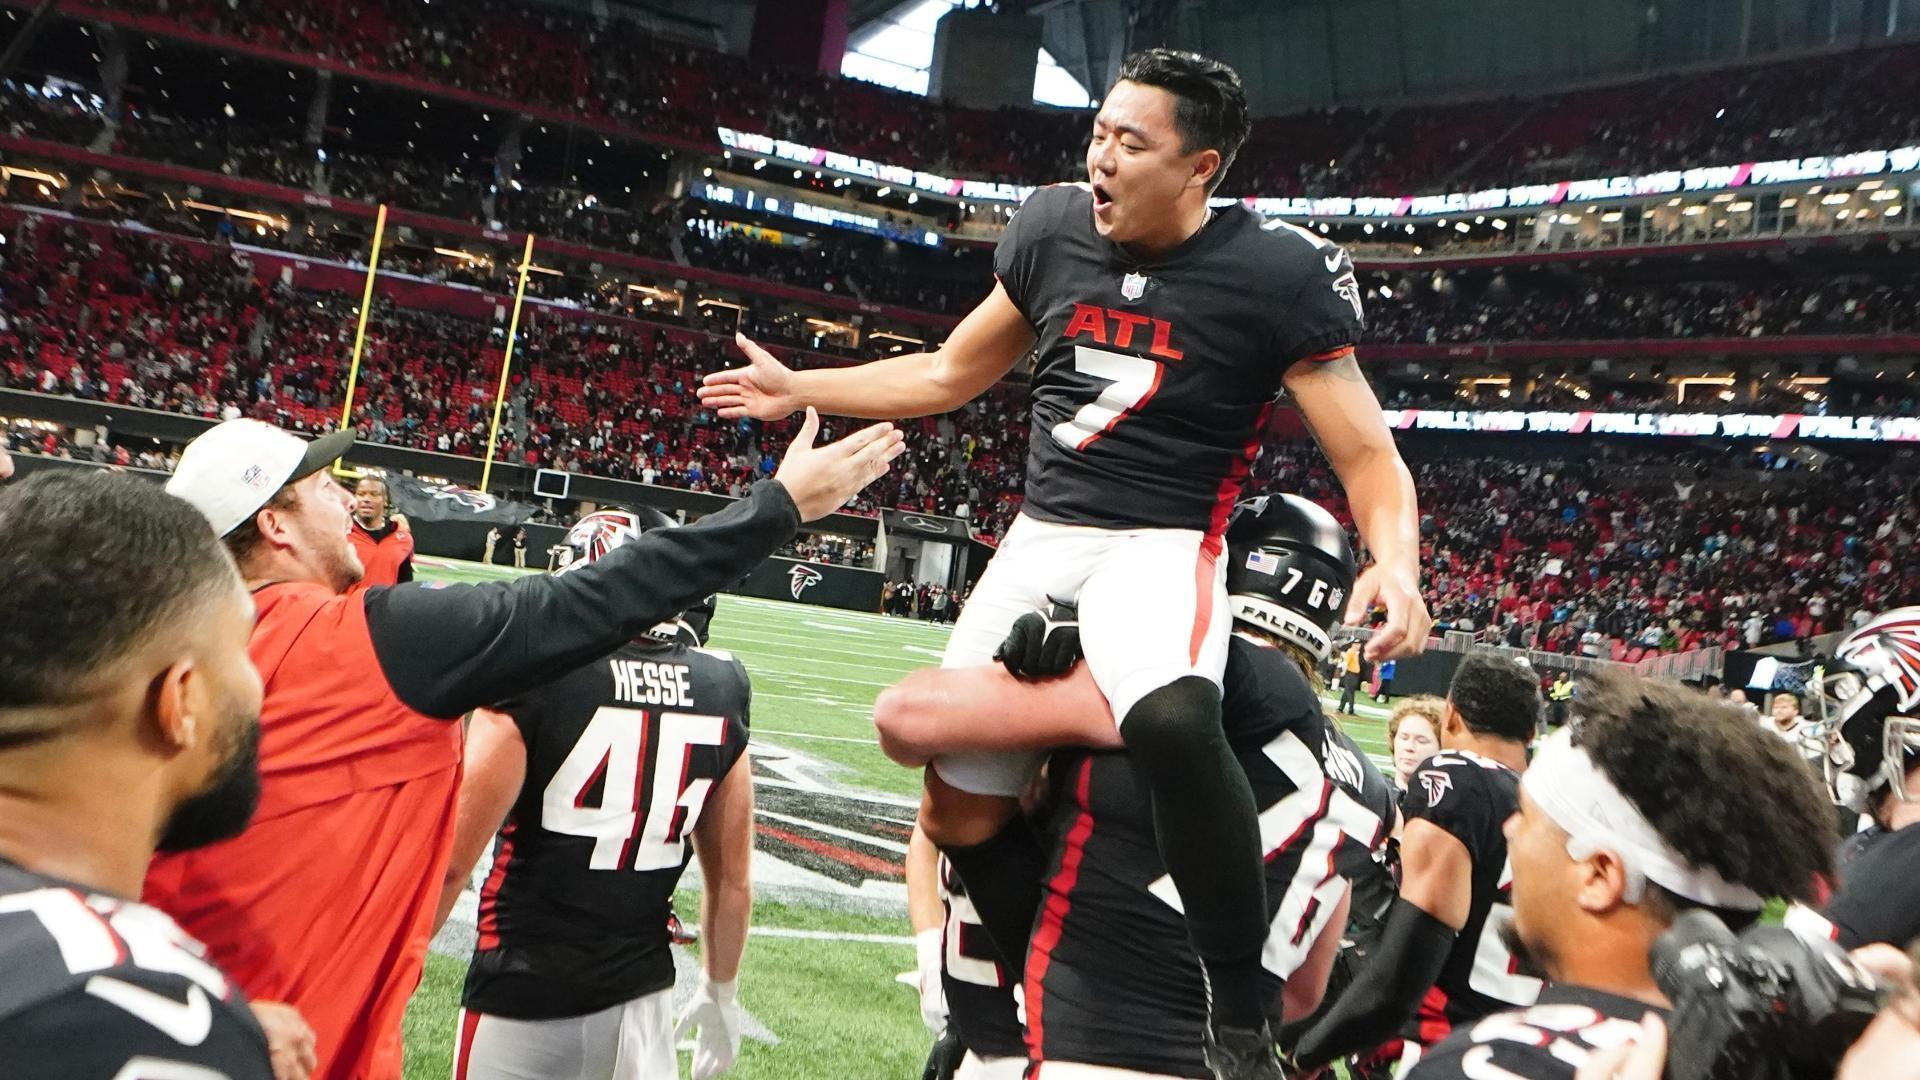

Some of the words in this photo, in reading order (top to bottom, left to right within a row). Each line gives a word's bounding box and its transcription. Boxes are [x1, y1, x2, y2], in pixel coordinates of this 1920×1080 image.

[1063, 303, 1184, 361] ATL
[1051, 345, 1165, 452] 7
[1281, 567, 1328, 609] 76
[1241, 605, 1325, 652] FALCONS
[609, 658, 694, 707] HESSE
[541, 706, 729, 872] 46
